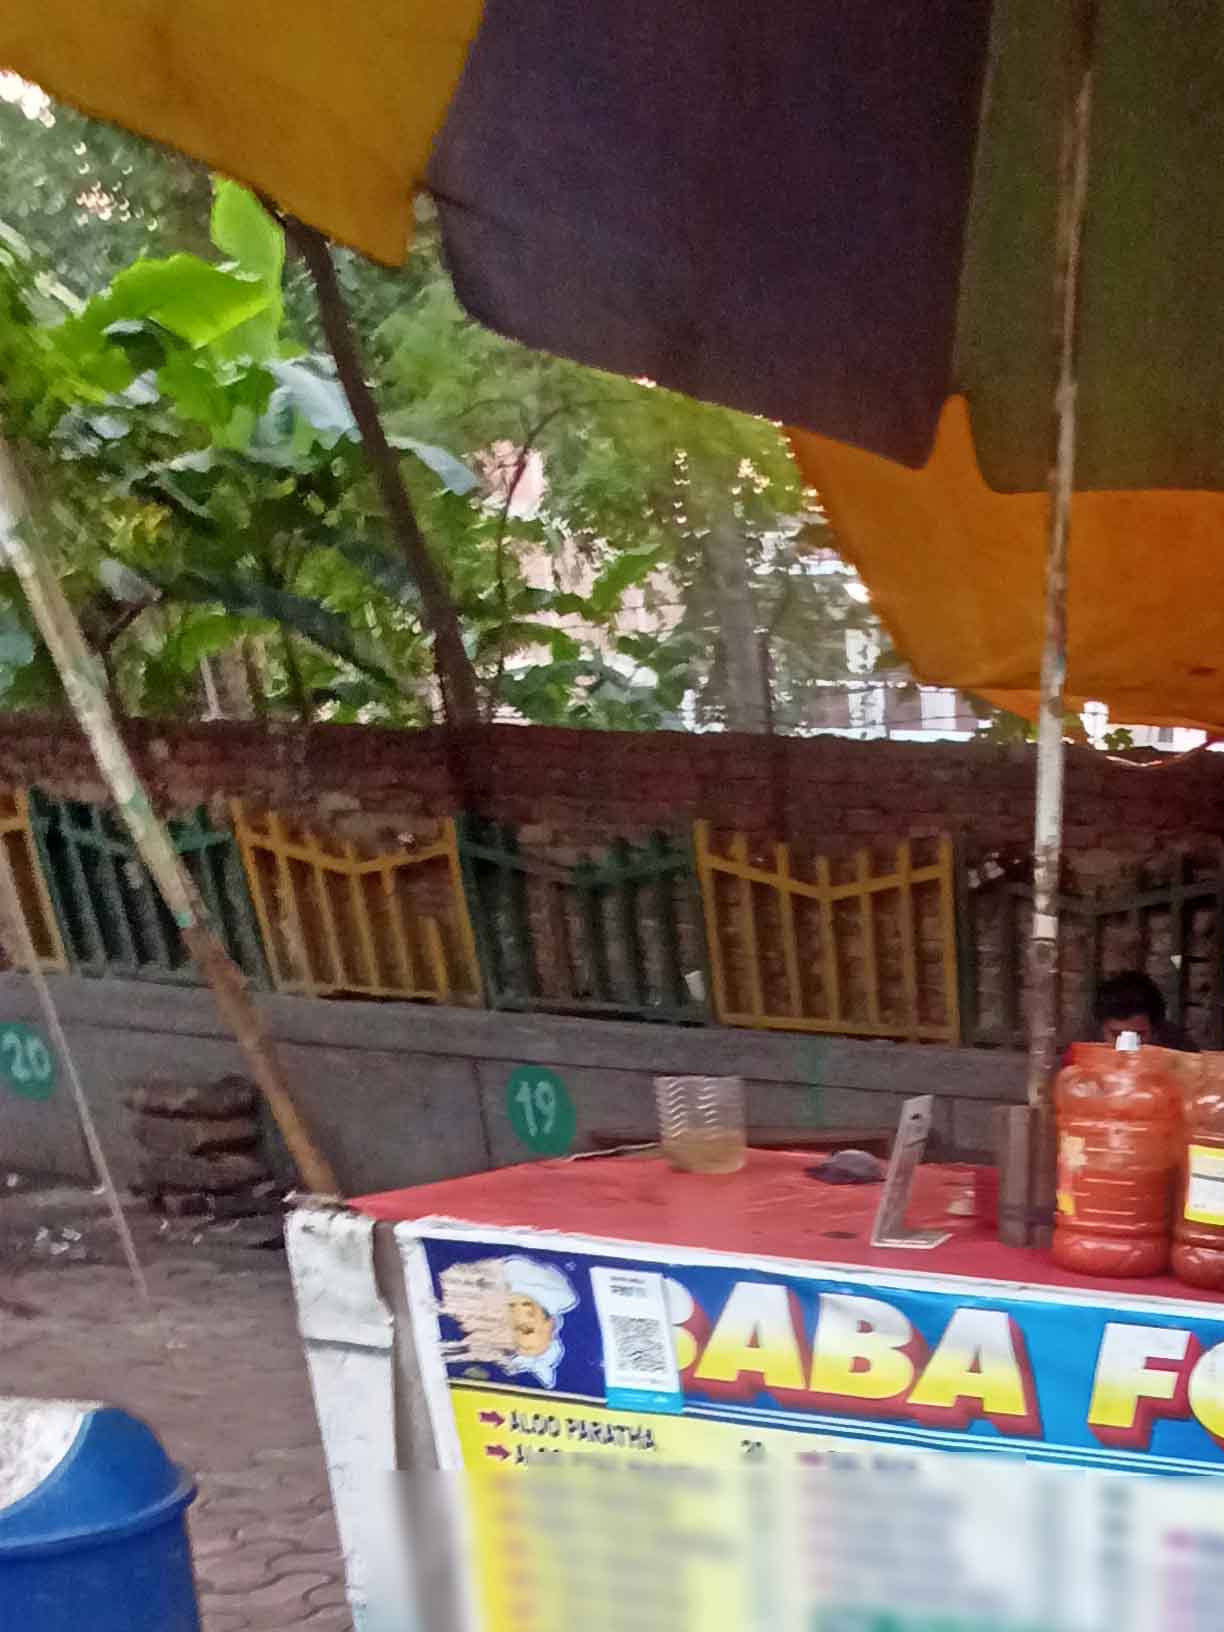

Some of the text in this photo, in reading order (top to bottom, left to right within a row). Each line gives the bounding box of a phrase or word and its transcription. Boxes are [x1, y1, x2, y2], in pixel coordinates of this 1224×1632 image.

[513, 1076, 557, 1137] 19
[509, 1410, 560, 1438] ALOO
[564, 1417, 660, 1451] PARATHA
